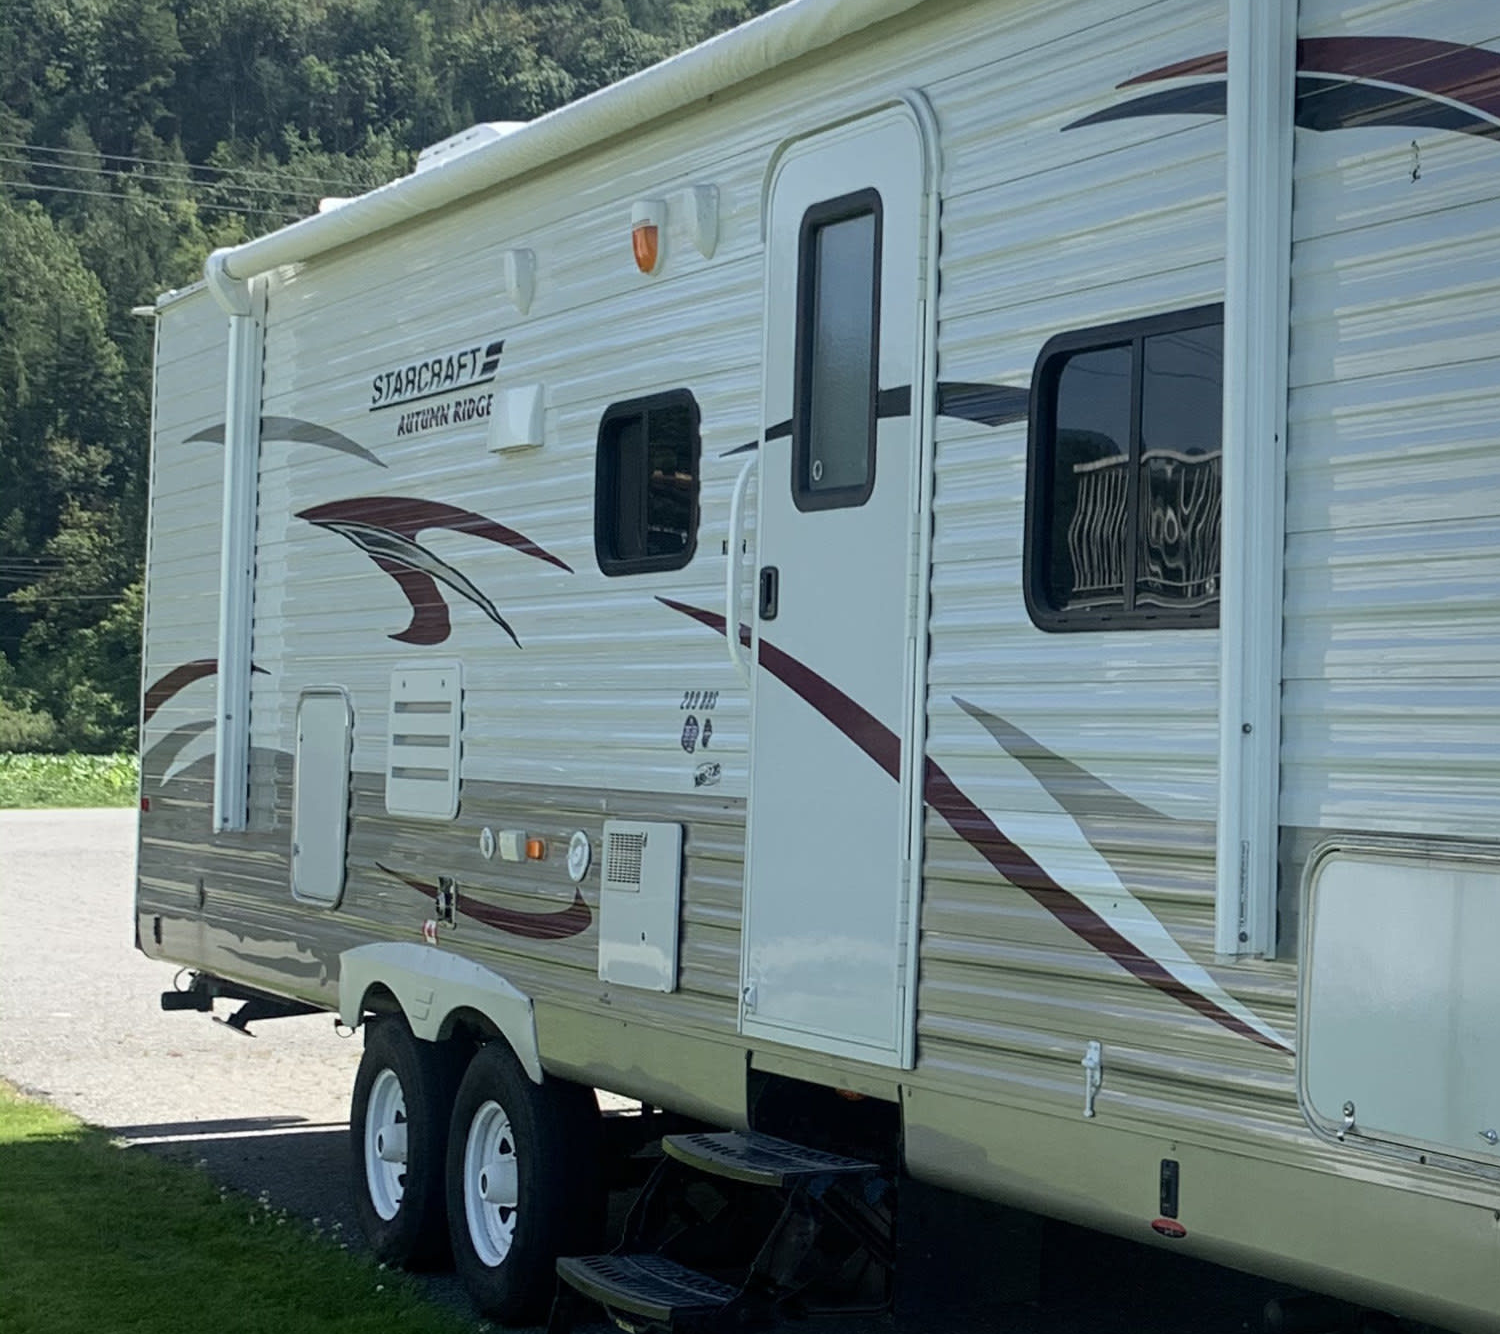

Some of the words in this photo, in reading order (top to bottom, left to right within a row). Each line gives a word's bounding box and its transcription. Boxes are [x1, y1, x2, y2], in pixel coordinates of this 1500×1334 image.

[371, 347, 483, 405] STARCRAFT
[397, 403, 451, 437] AUTUMN
[453, 393, 494, 423] RIDGE
